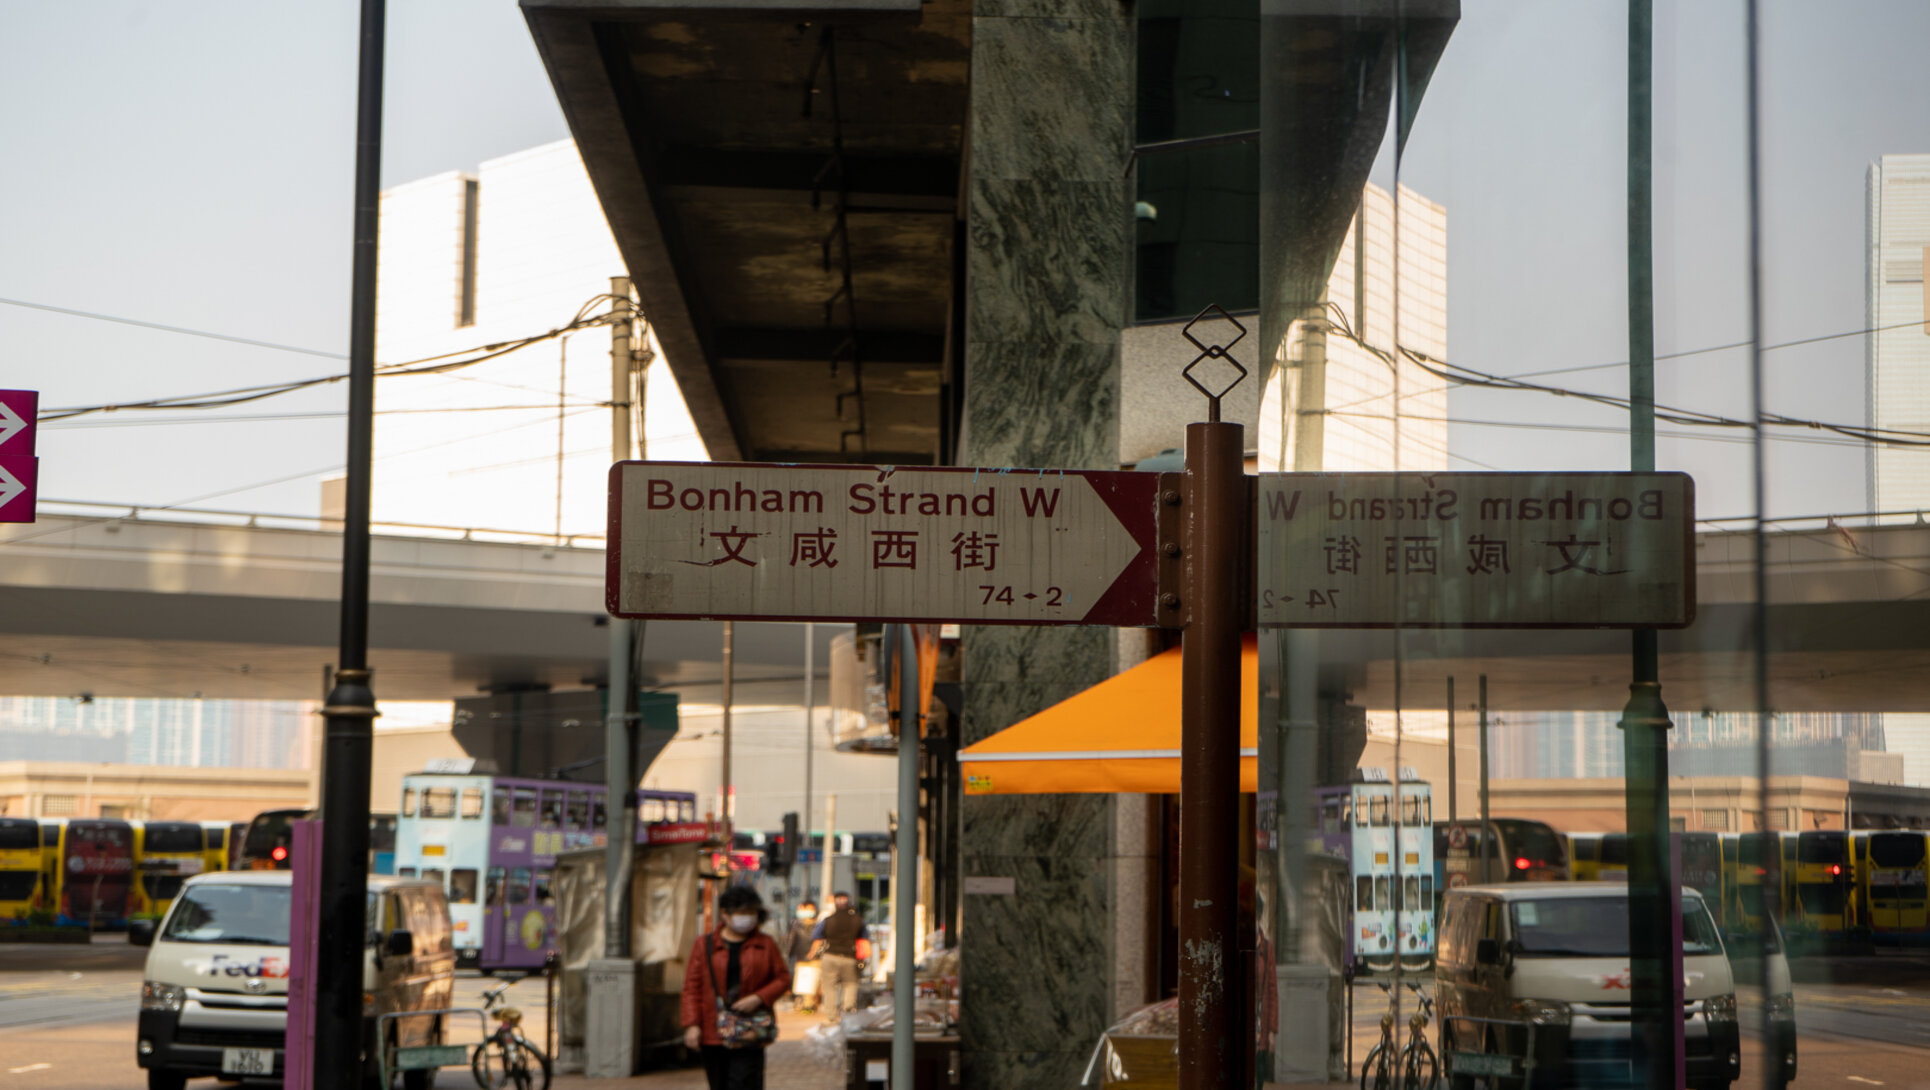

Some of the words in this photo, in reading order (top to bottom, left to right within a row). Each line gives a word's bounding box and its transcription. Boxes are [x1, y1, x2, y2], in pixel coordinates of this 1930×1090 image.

[647, 479, 824, 513] Bonham
[848, 485, 995, 517] Strand
[1019, 487, 1062, 519] W
[709, 526, 1000, 571] 文咸西街
[979, 585, 1015, 606] 74
[1046, 586, 1062, 607] 2
